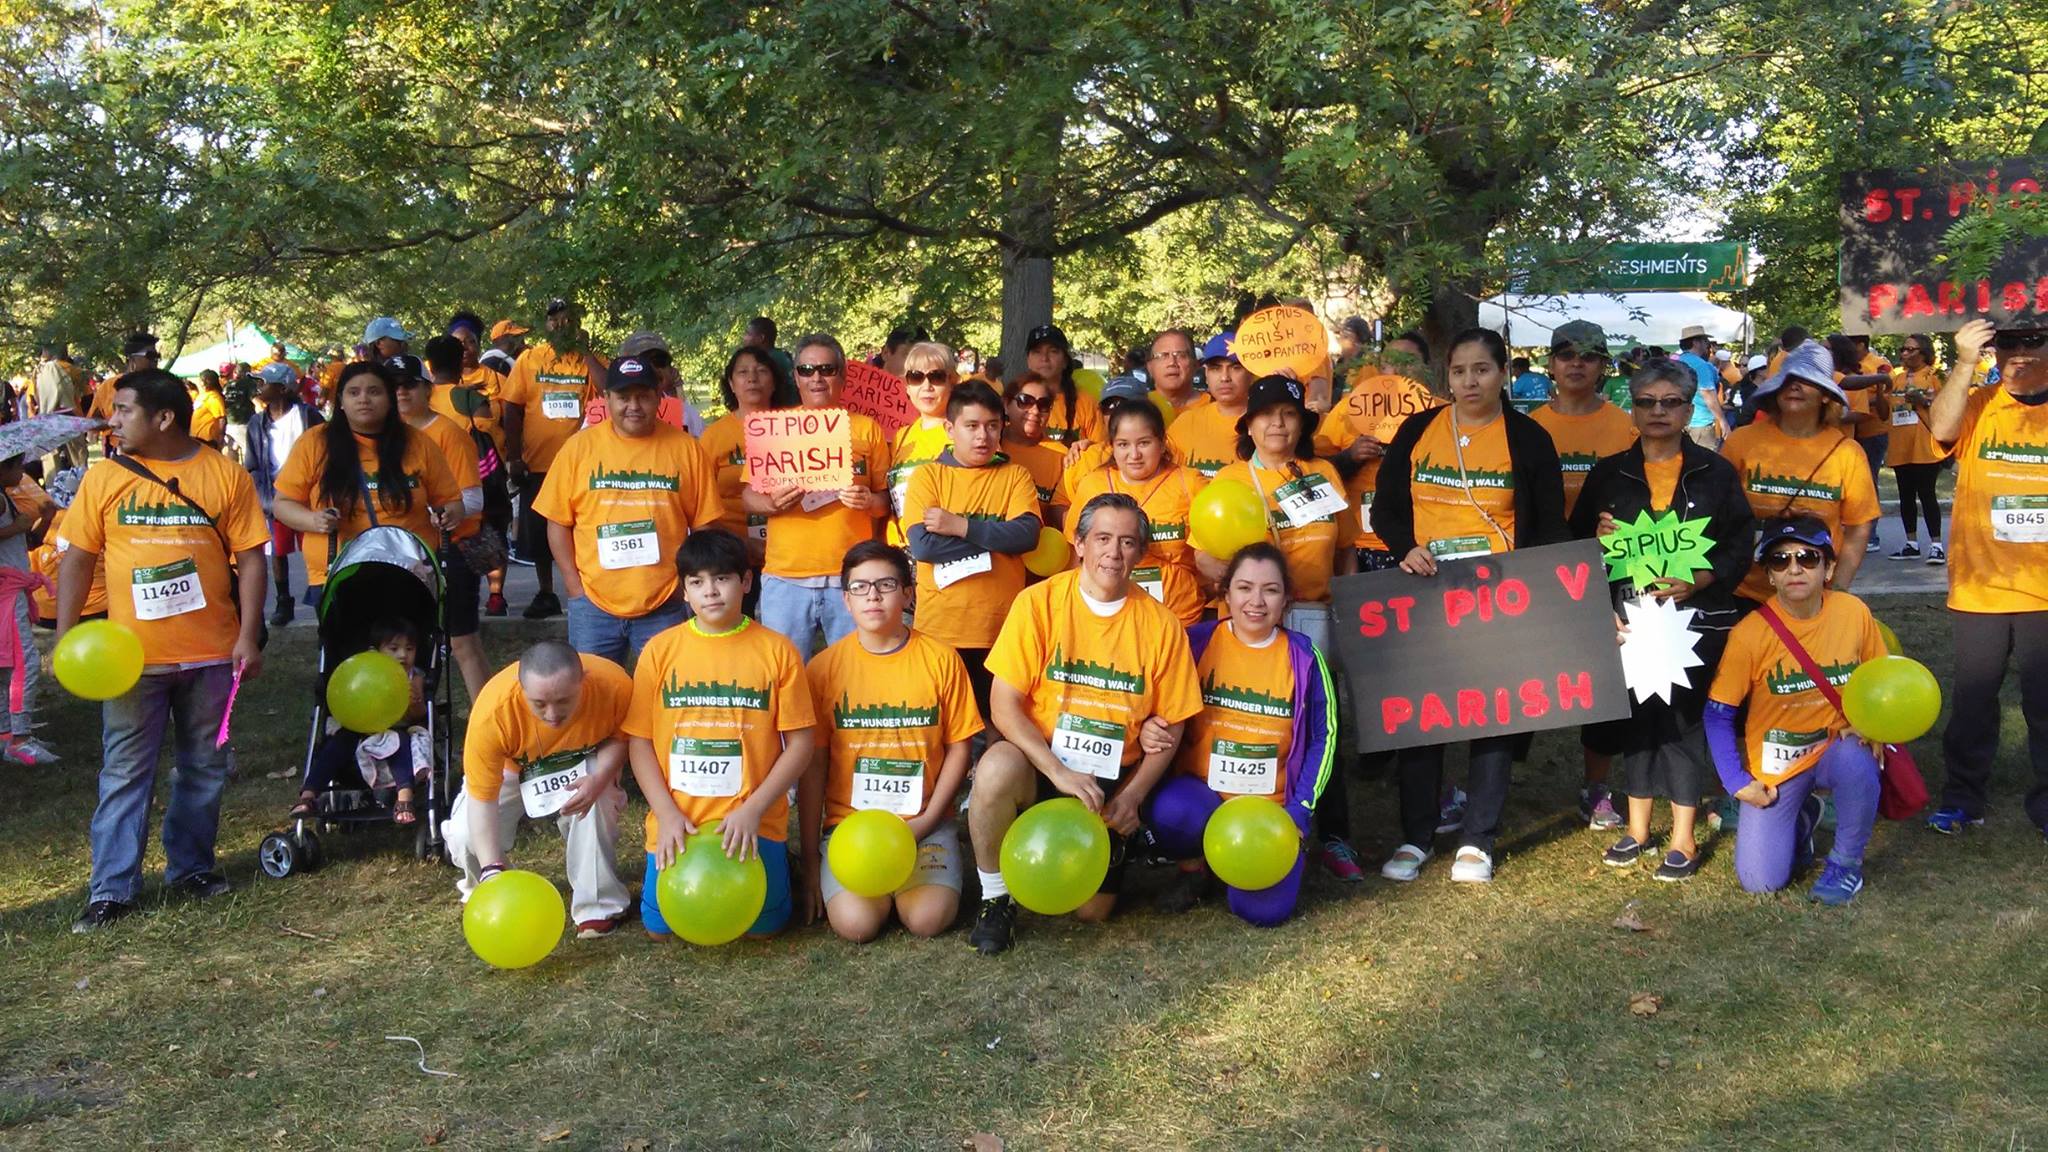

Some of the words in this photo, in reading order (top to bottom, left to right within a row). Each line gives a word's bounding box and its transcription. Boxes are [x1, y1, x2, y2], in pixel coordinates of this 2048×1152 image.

[1865, 188, 1934, 223] ST.
[1275, 308, 1302, 321] PIUS
[1273, 322, 1281, 330] V
[1241, 329, 1294, 346] PARISH
[1242, 349, 1272, 361] FOOD
[1273, 343, 1318, 360] PANTRY
[868, 370, 901, 396] PIUS
[842, 380, 907, 414] PARISH
[1372, 393, 1415, 417] PIUS
[748, 417, 779, 437] ST.
[785, 414, 819, 436] PIO
[824, 414, 841, 433] V
[750, 447, 843, 476] PARISH
[2002, 453, 2042, 463] HUNGER
[612, 481, 646, 489] HUNGER
[1475, 479, 1505, 487] WALK
[1290, 488, 1329, 509] 1191
[1807, 489, 1833, 499] WALK
[146, 516, 187, 525] HUNGER
[190, 516, 209, 525] WAL
[2006, 513, 2045, 524] 6845
[612, 538, 645, 551] 3561
[1152, 531, 1179, 541] WALK
[1612, 537, 1635, 560] ST.
[1638, 527, 1697, 556] PIUS
[142, 580, 191, 600] 11420
[1359, 596, 1416, 637] ST
[1555, 562, 1590, 601] V
[1068, 673, 1106, 689] HUNGER
[1108, 680, 1136, 692] WALK
[1796, 677, 1838, 691] HUNR
[687, 696, 730, 706] HUNGER
[732, 697, 761, 708] WALK
[1220, 698, 1262, 713] HUNGER
[1263, 705, 1291, 717] WALK
[1381, 671, 1594, 735] PARISH
[861, 718, 901, 727] HUNGER
[902, 717, 930, 726] WALK
[1063, 735, 1112, 756] 11409
[680, 760, 730, 775] 11407
[1219, 760, 1266, 775] 11425
[532, 770, 579, 796] 11893
[864, 778, 911, 793] 11415
